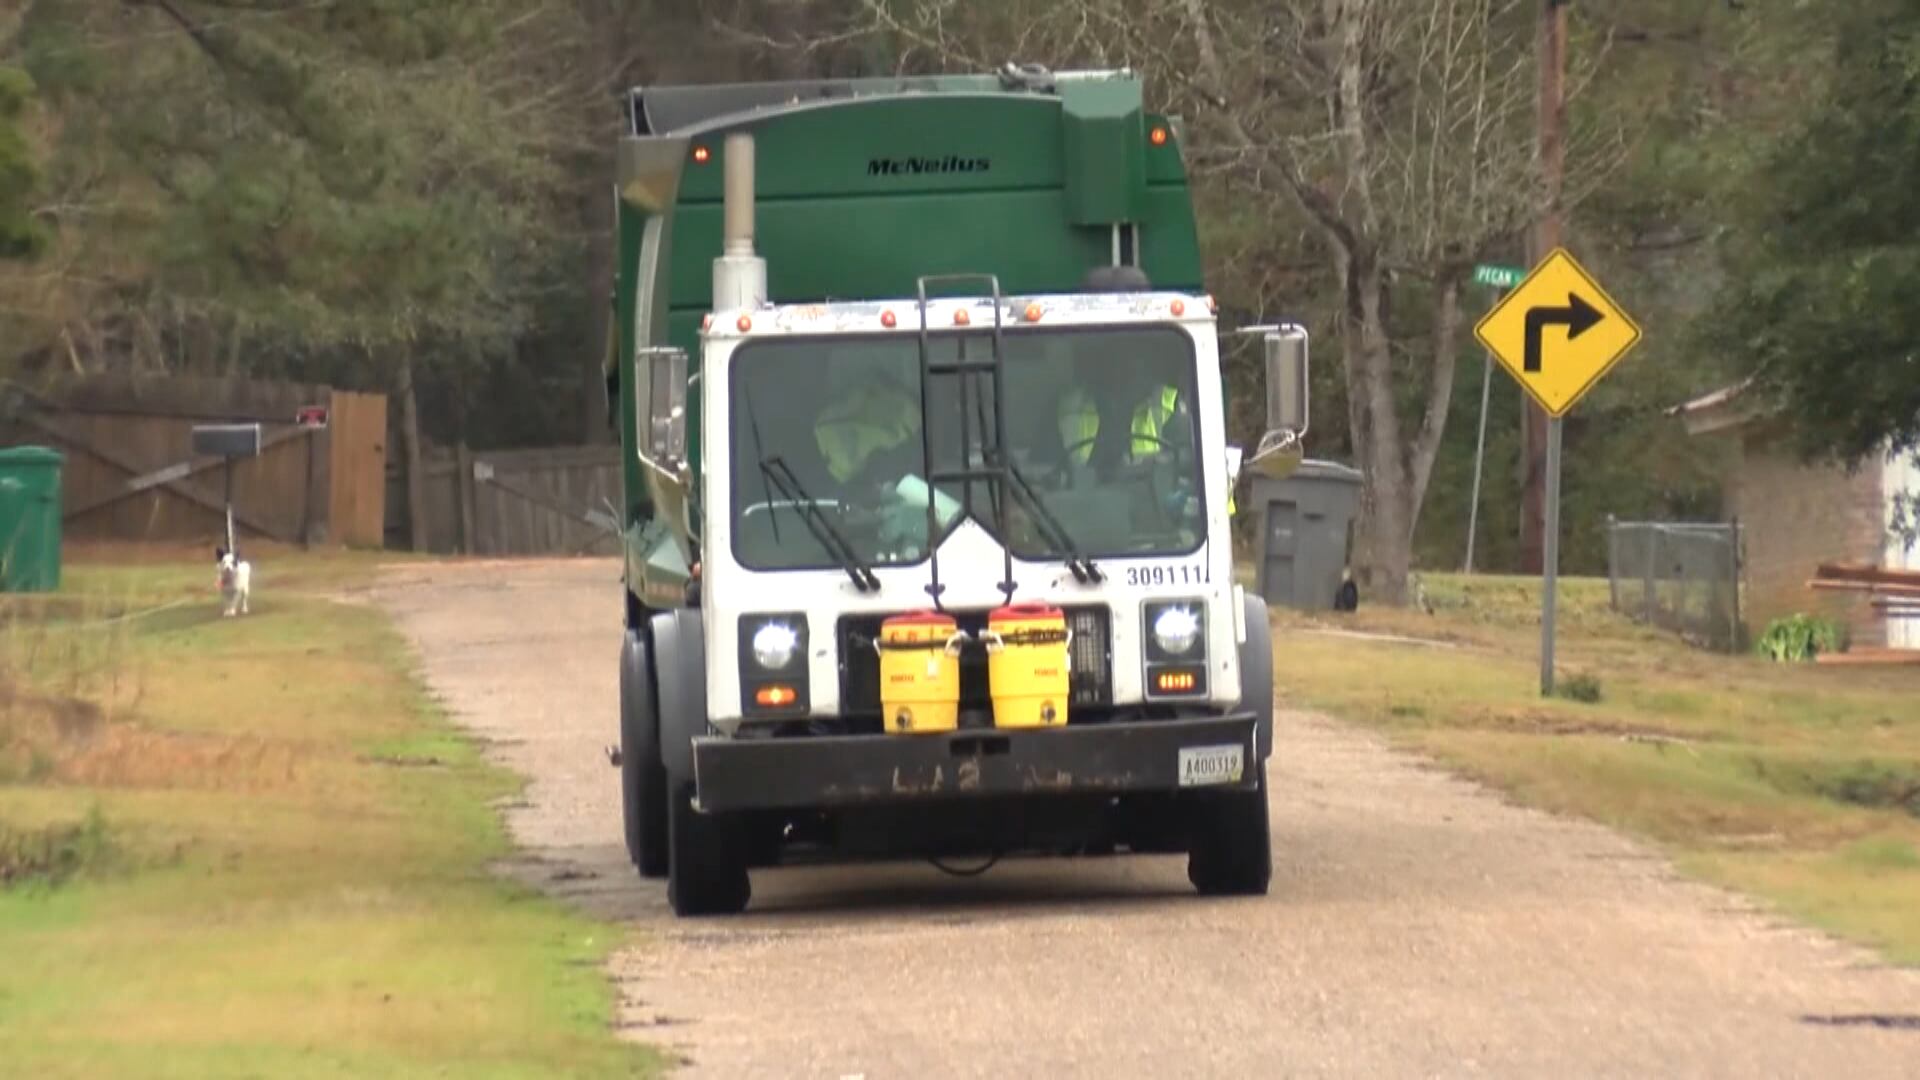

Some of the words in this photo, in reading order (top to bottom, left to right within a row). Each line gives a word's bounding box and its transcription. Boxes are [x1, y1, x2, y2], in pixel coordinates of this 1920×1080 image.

[867, 155, 990, 176] McNeilus
[1478, 266, 1512, 286] PECAN
[1127, 565, 1201, 586] 309111
